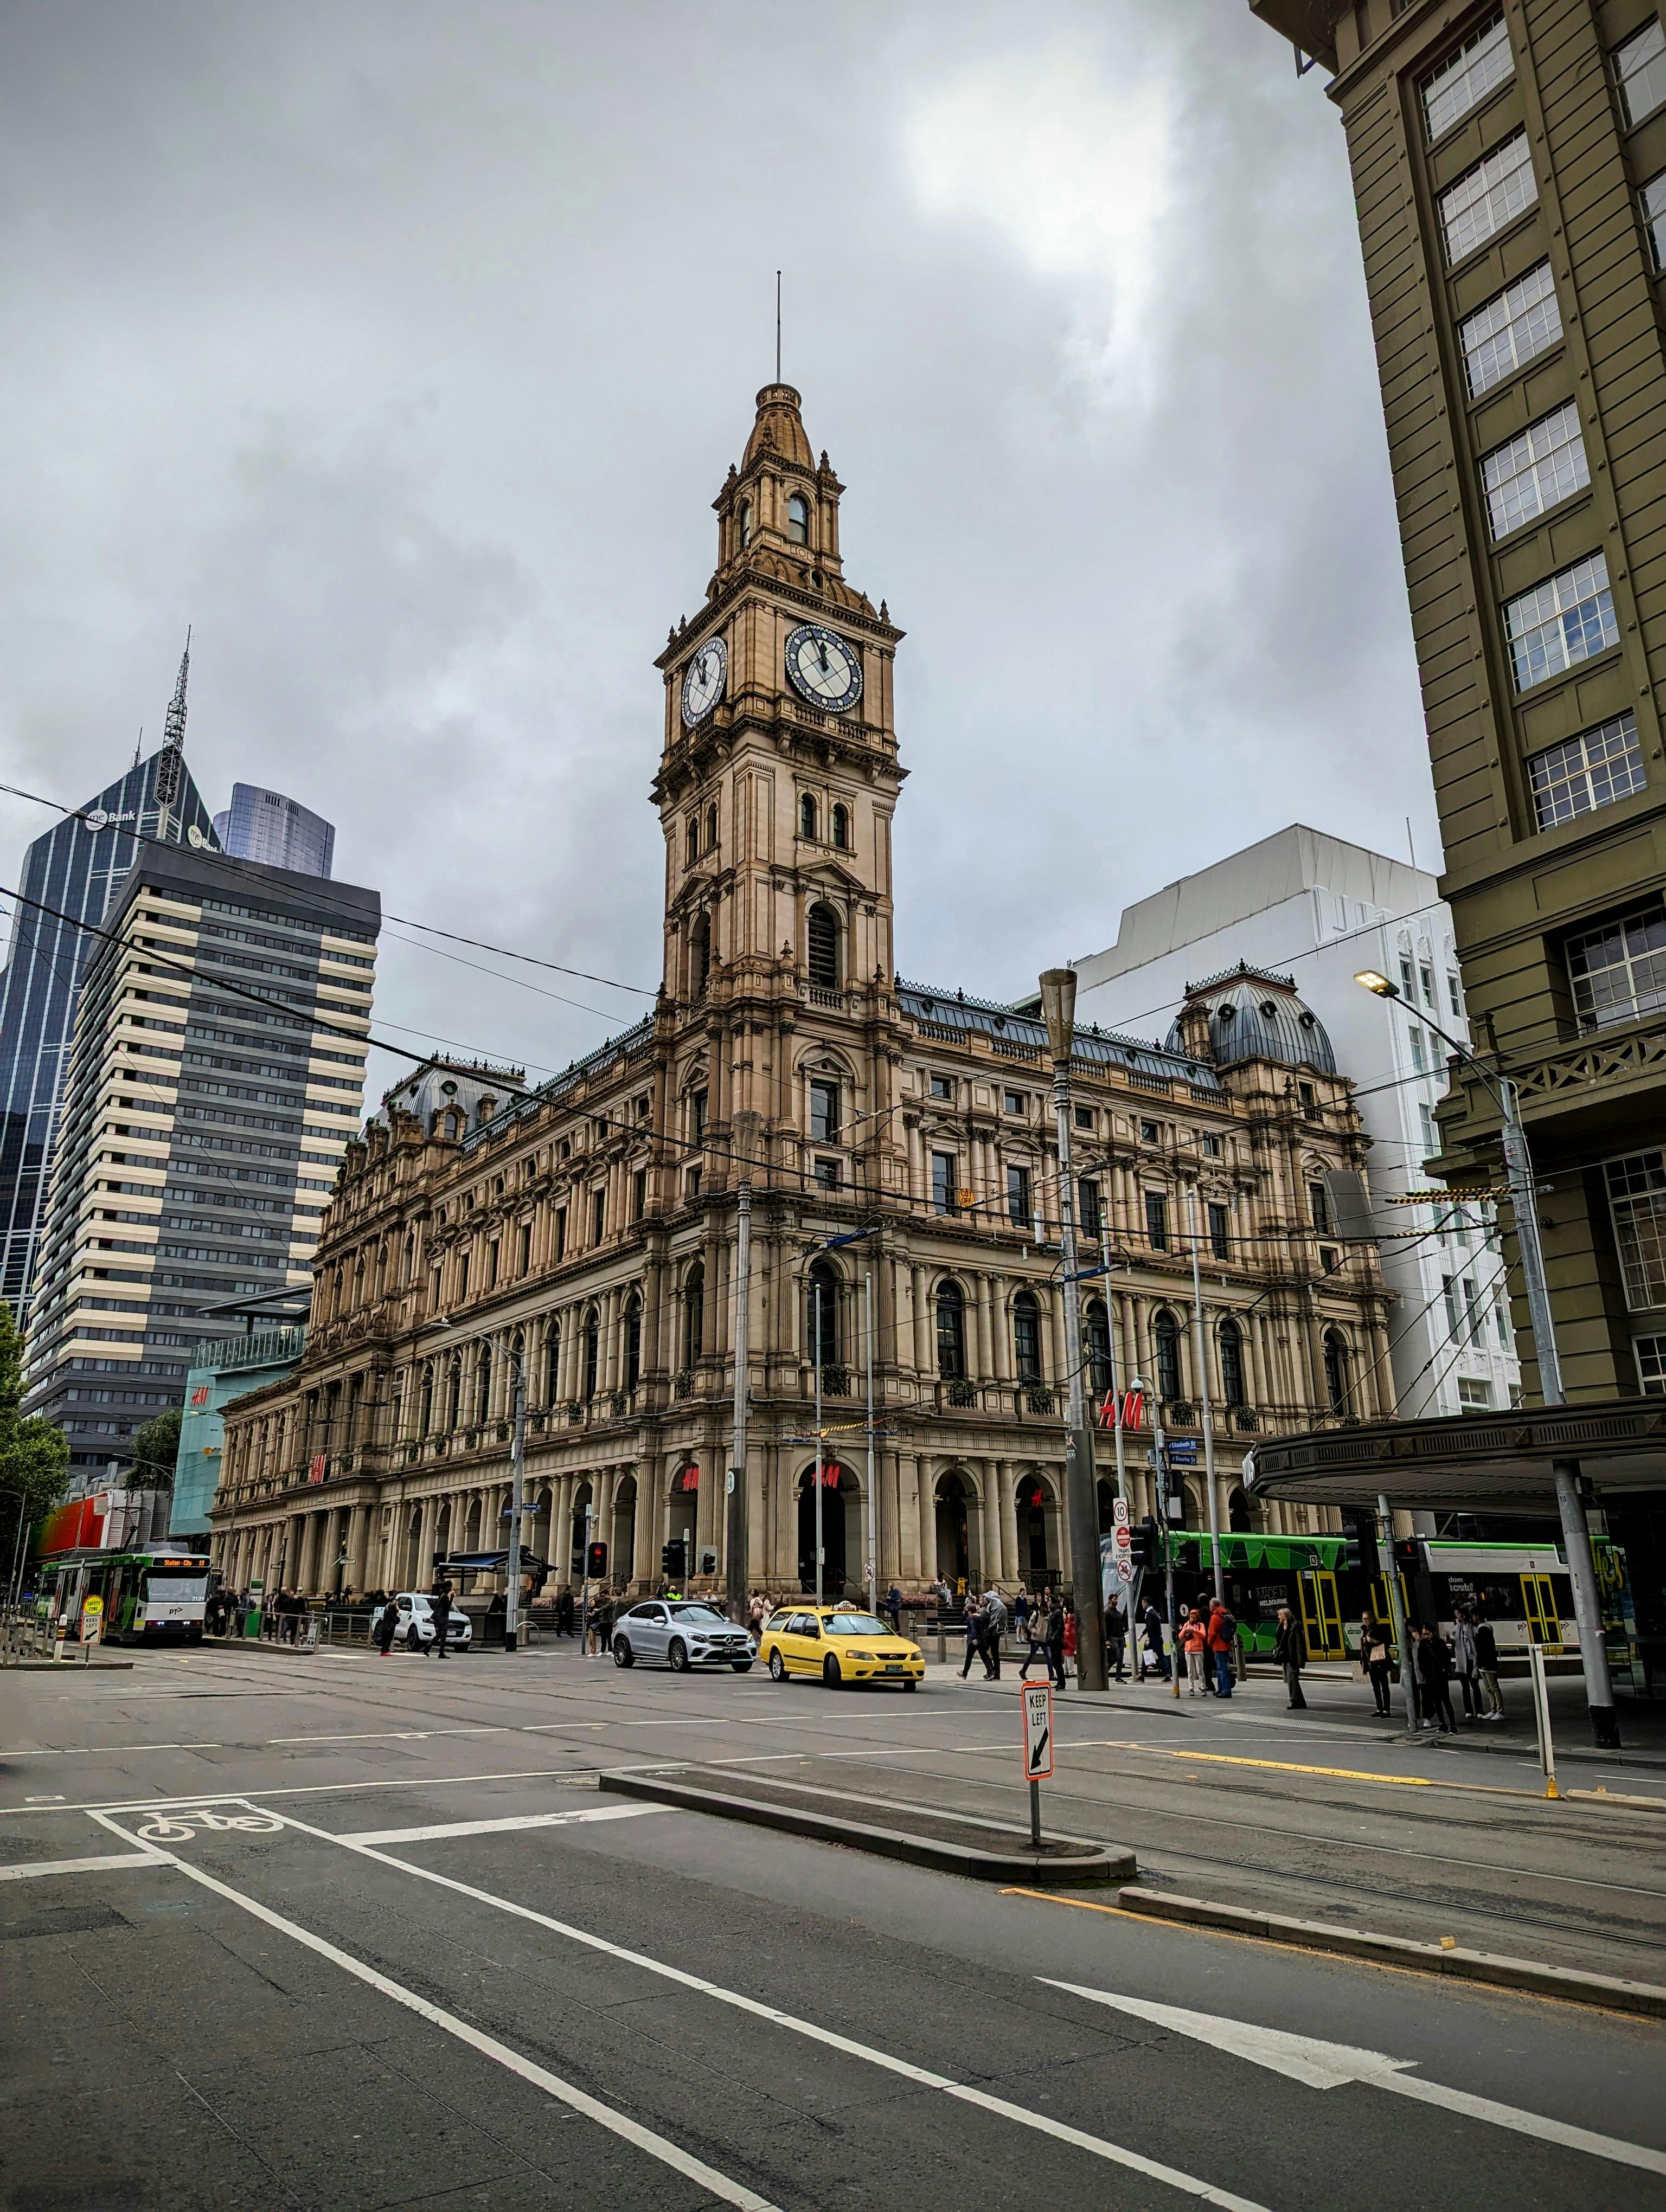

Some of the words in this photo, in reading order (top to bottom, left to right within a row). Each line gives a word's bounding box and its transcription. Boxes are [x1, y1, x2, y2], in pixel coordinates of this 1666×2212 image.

[108, 811, 136, 822] Bank
[1117, 1507, 1125, 1517] 10
[1259, 1598, 1289, 1606] MELBOURNE
[1029, 1694, 1047, 1708] KEEP
[1031, 1712, 1047, 1726] LEFT
